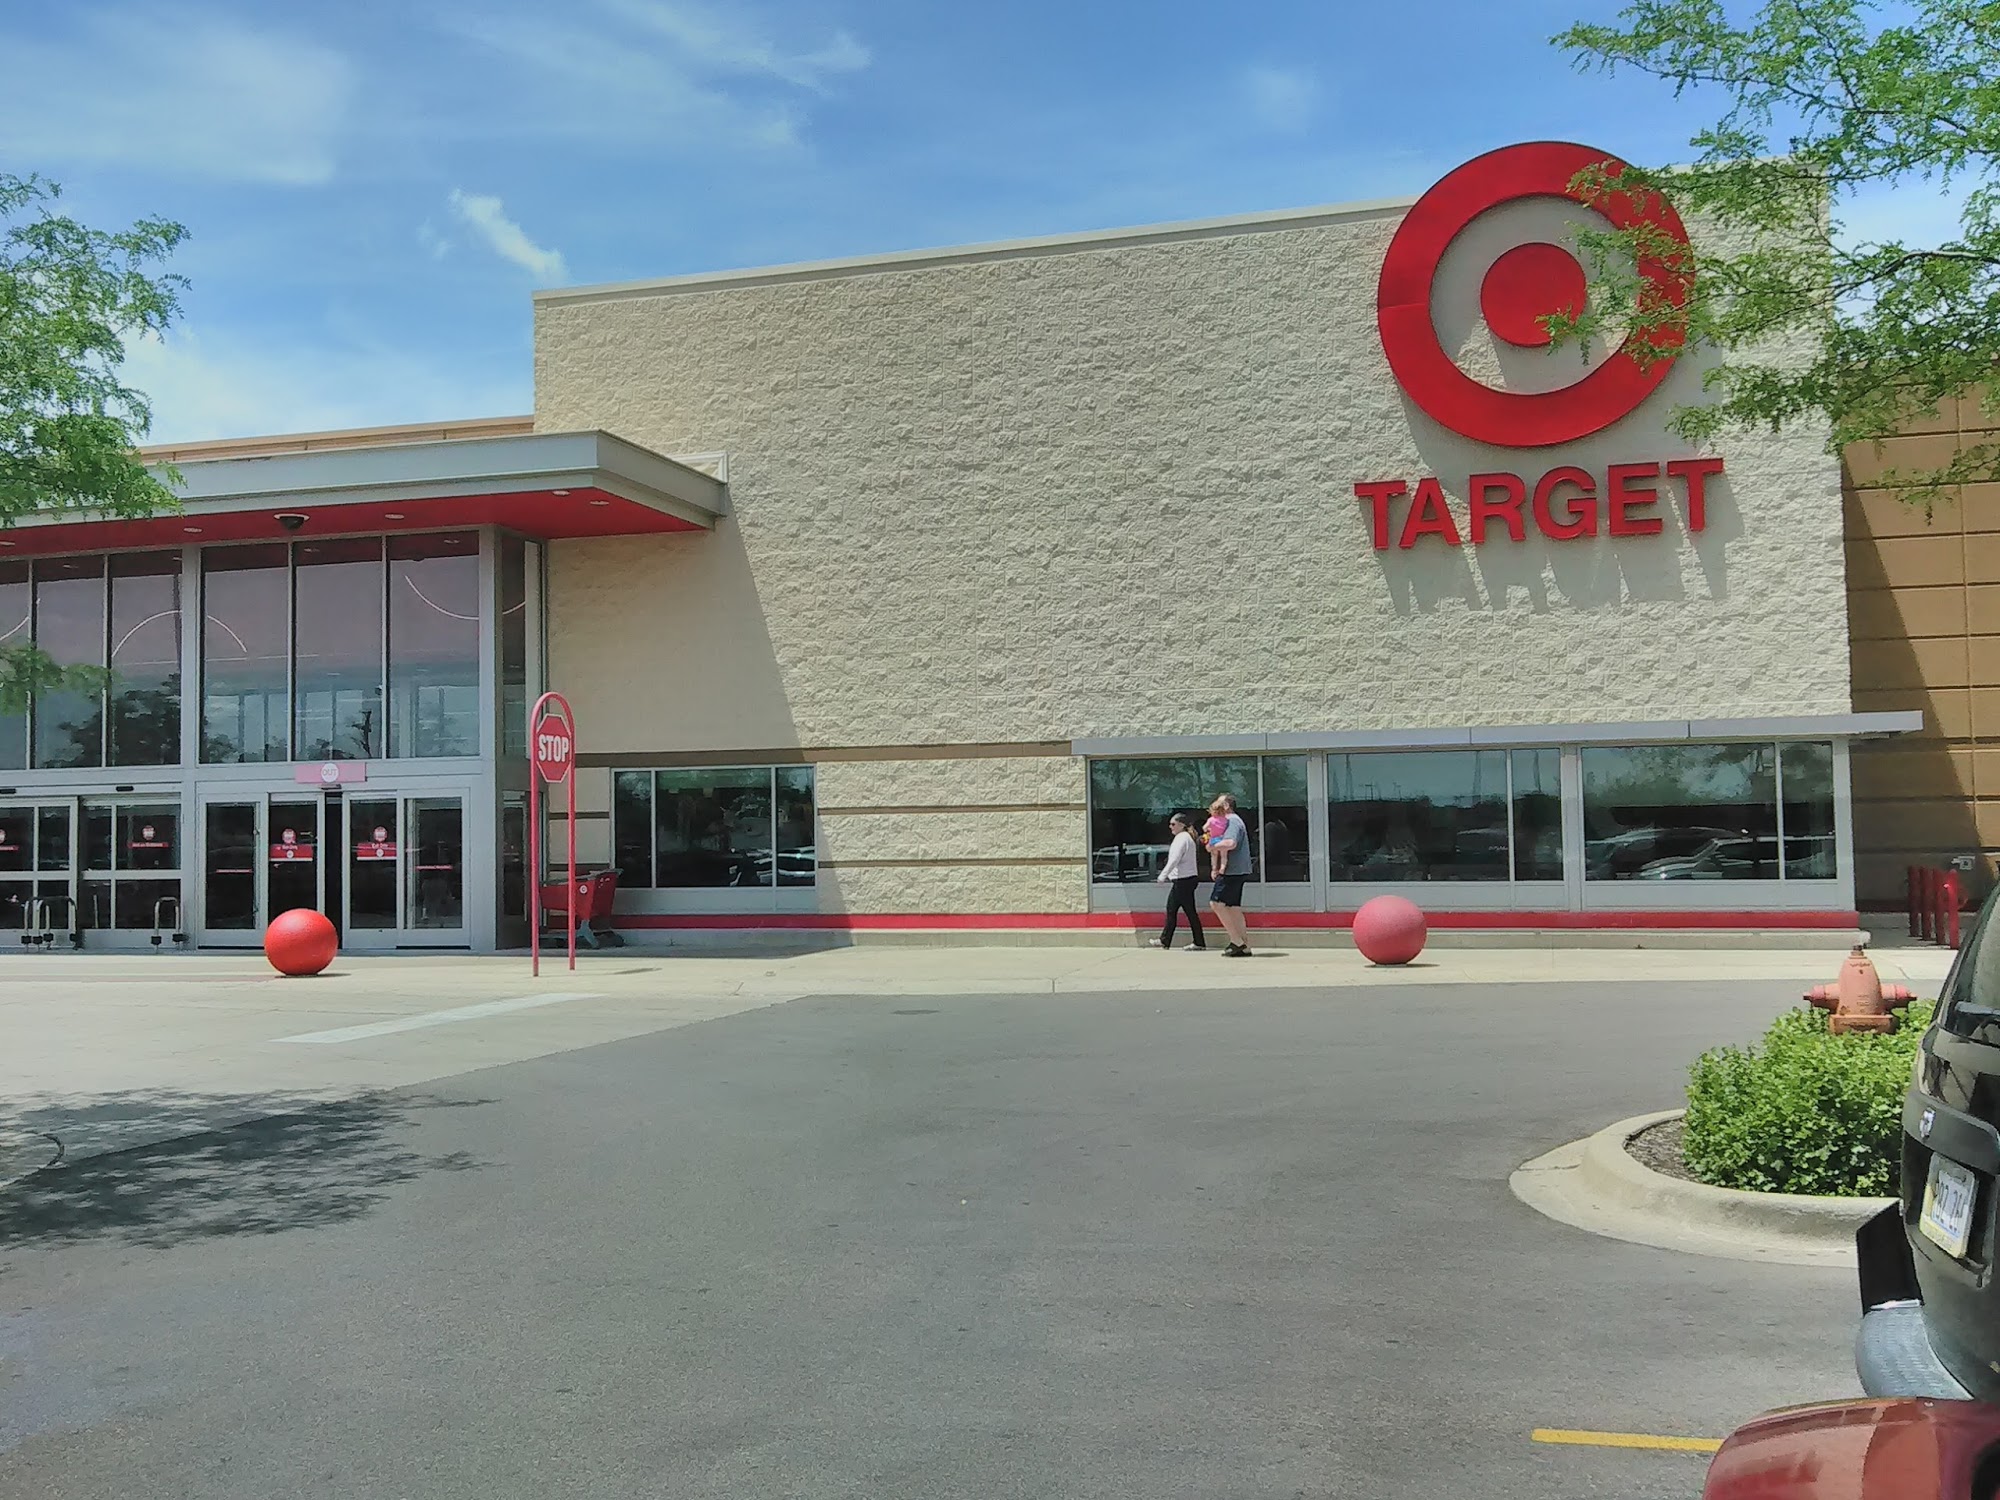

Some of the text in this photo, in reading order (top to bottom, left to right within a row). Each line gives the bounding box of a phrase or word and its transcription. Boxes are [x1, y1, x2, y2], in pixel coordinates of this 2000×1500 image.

[1354, 458, 1724, 550] TARGET
[538, 734, 570, 762] STOP
[322, 768, 338, 777] OUT
